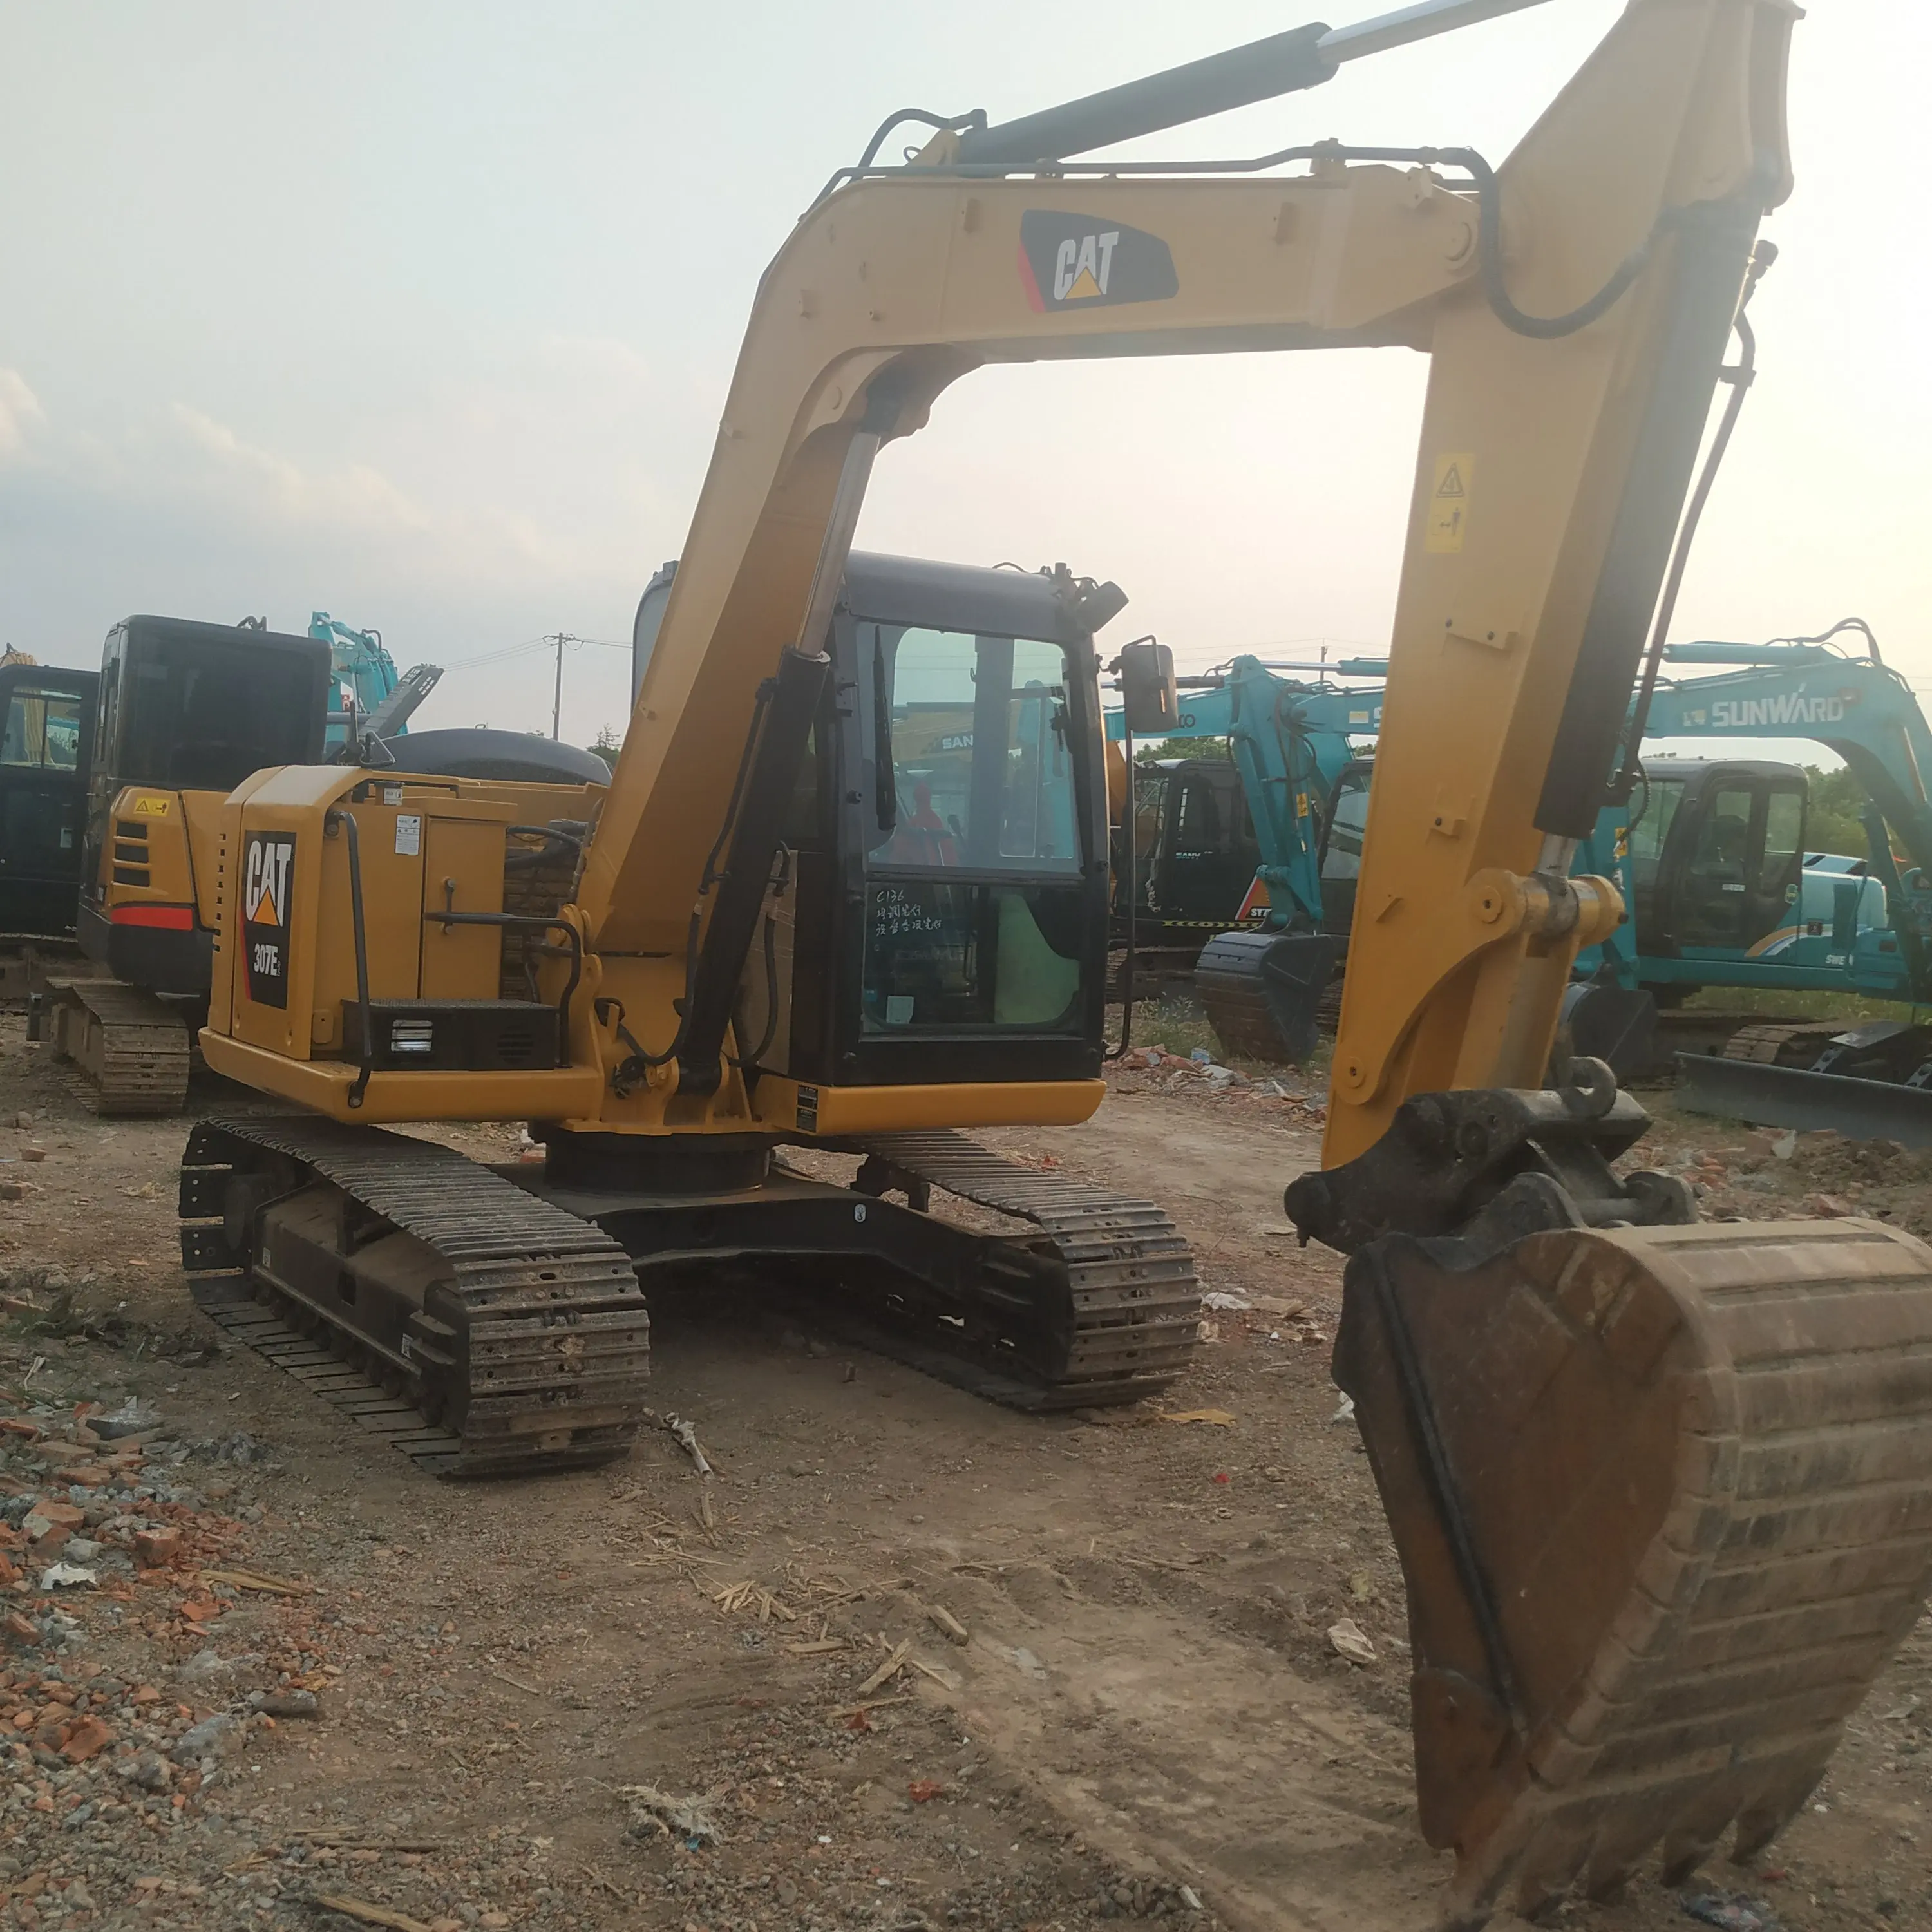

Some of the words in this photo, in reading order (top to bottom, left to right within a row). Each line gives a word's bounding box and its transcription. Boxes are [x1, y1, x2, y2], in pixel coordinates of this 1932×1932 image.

[1054, 231, 1119, 300] CAT
[1712, 683, 1844, 727] SUNWARD
[245, 840, 292, 927] CAT
[876, 889, 904, 902] C136
[254, 943, 278, 976] 307E
